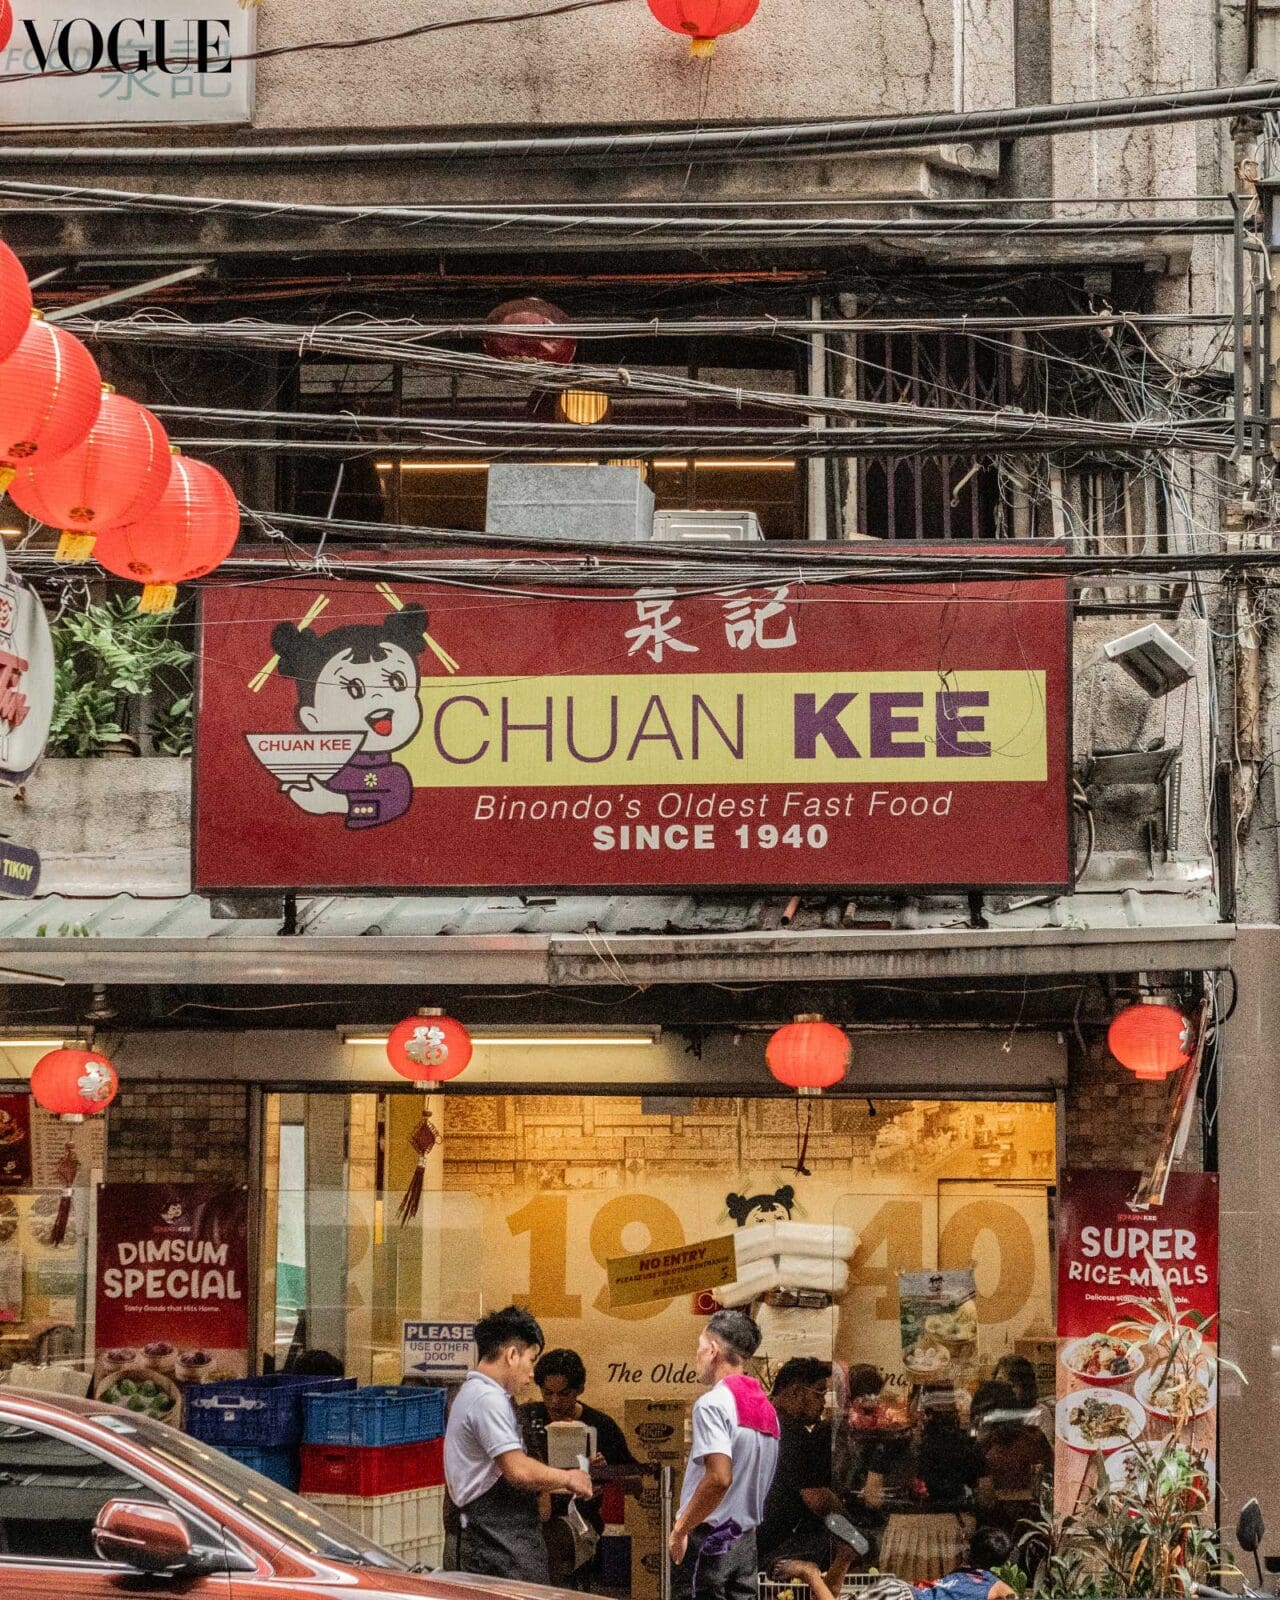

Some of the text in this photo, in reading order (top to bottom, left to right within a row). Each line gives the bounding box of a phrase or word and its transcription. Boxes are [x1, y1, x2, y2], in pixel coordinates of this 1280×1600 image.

[434, 691, 991, 765] CHUAN KEE
[258, 739, 351, 751] CHUAN KEE
[474, 791, 953, 820] Binondo's Oldest Fast Food
[593, 824, 828, 850] SINCE 1940
[3, 859, 34, 881] TIKOY
[118, 1239, 228, 1266] DIMSUM
[1081, 1226, 1197, 1260] SUPER
[640, 1248, 706, 1271] NO ENTRY
[104, 1268, 242, 1300] SPECIAL
[1068, 1261, 1122, 1286] RICE
[406, 1326, 474, 1339] PLEASE
[410, 1342, 469, 1352] USE OTHER
[425, 1352, 455, 1361] DOOR
[608, 1362, 643, 1383] The
